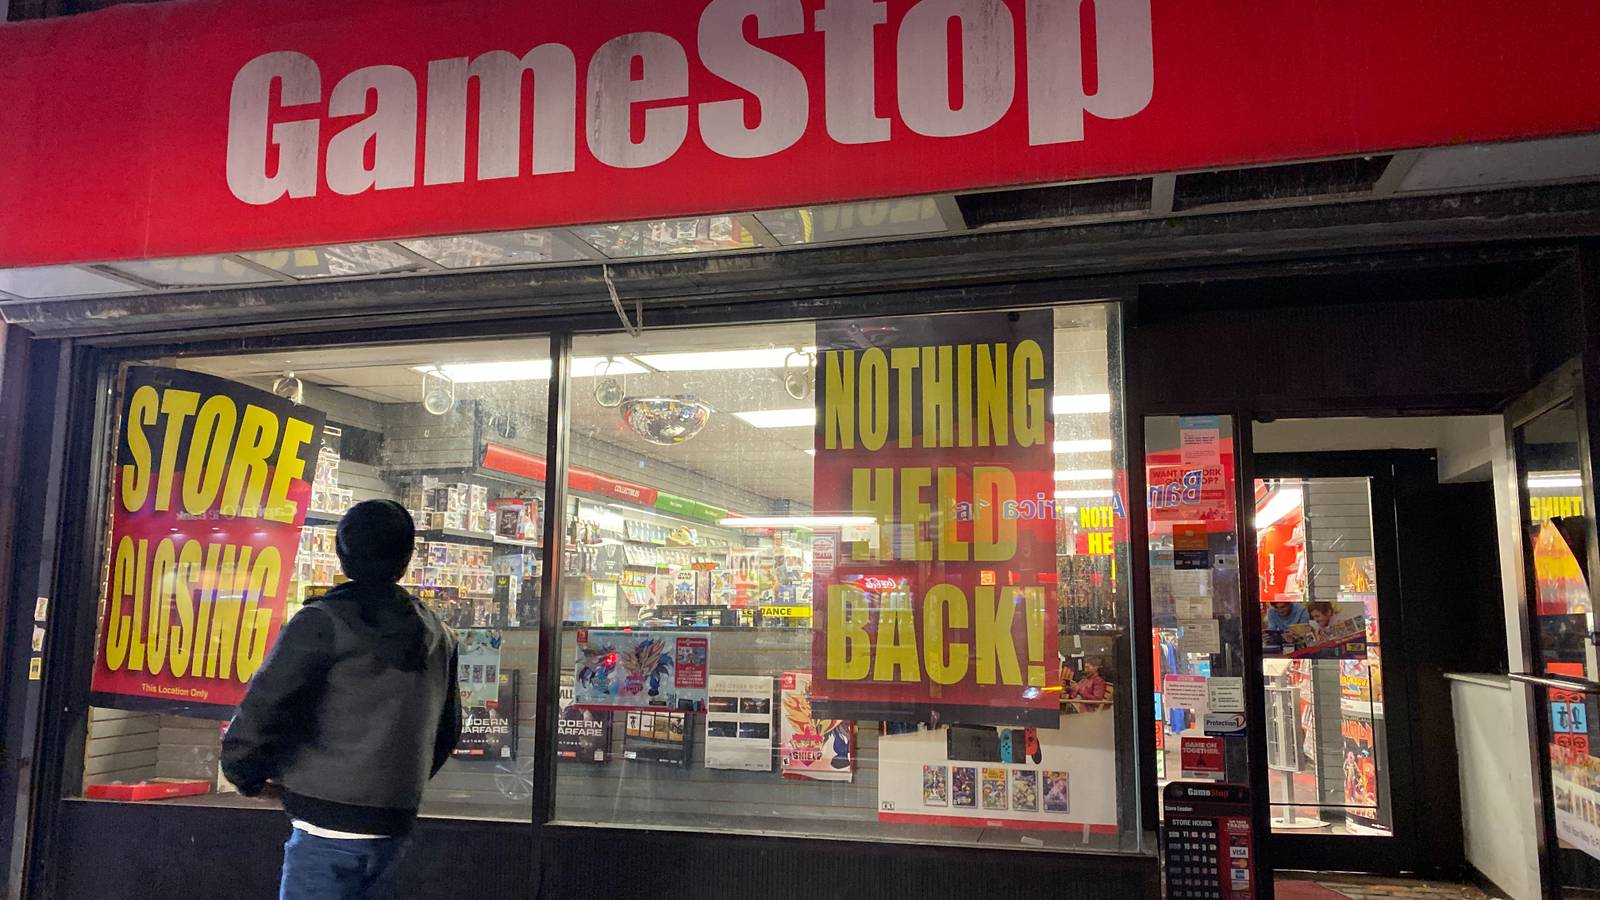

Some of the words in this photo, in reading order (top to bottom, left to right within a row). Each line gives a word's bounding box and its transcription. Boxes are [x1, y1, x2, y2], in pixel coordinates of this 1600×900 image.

[224, 0, 1155, 207] GameStop
[824, 339, 1046, 452] NOTHING
[121, 384, 315, 525] STORE
[852, 465, 1018, 563] HELD
[106, 535, 282, 684] CLOSING
[826, 583, 1046, 687] BACK!
[142, 682, 157, 693] This
[158, 685, 190, 697] Location
[190, 687, 209, 700] Only
[1206, 719, 1237, 728] Protection
[1172, 819, 1191, 827] STORE
[1192, 820, 1213, 828] HOURS
[1187, 788, 1229, 798] GameStop
